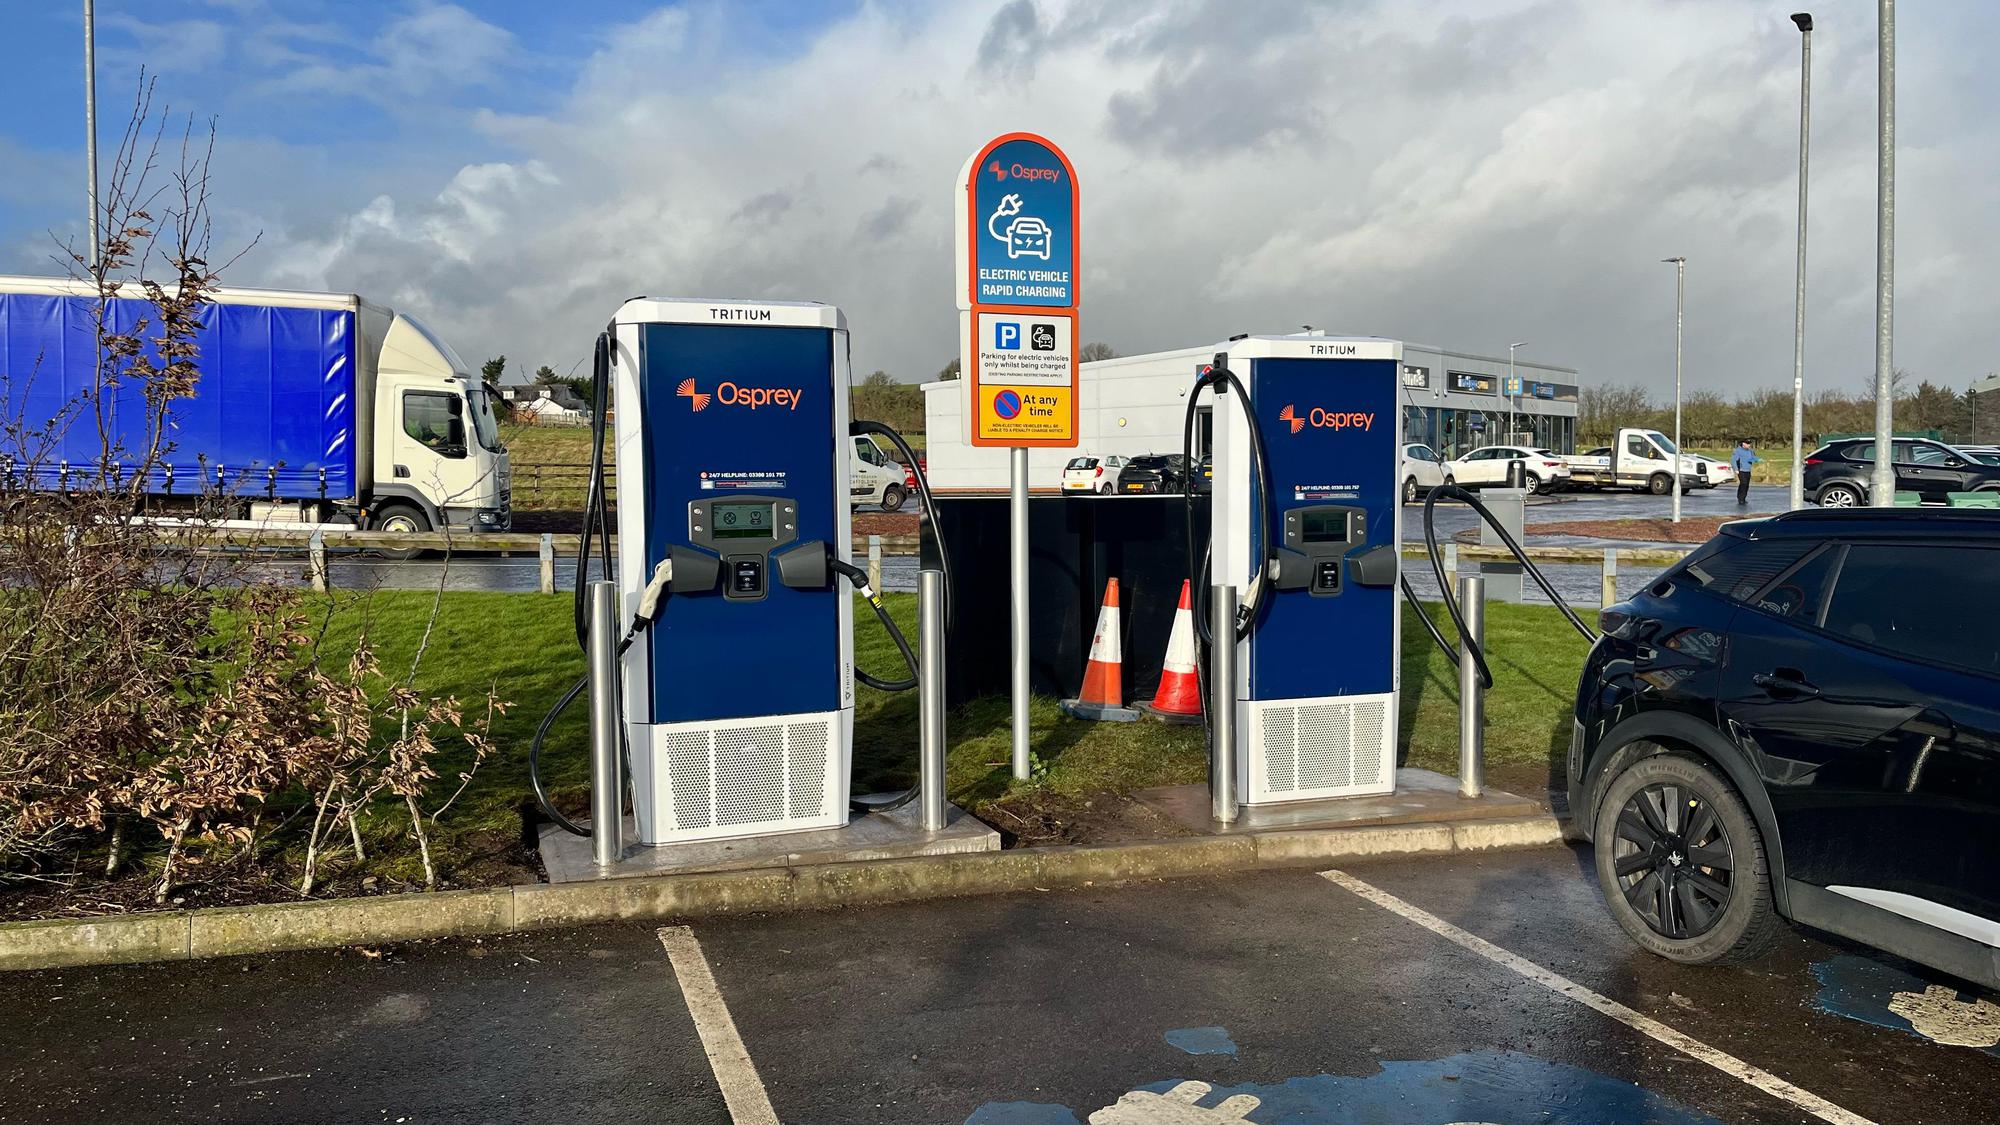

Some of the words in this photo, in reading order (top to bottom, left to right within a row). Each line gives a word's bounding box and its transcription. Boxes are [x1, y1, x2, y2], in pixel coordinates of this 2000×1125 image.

[1011, 164, 1060, 182] Osprey
[980, 268, 1026, 281] ELECTRIC
[1029, 270, 1068, 282] VEHICLE
[982, 285, 1013, 296] RAPID
[1016, 286, 1066, 298] CHARGING
[710, 308, 771, 320] TRITIUM
[1002, 326, 1016, 347] P
[1310, 345, 1356, 355] TRITIUM
[981, 353, 1006, 361] Parking
[718, 382, 802, 410] Osprey
[1023, 395, 1036, 405] At
[1039, 397, 1058, 406] any
[1030, 406, 1053, 416] time
[1310, 408, 1374, 431] Osprey
